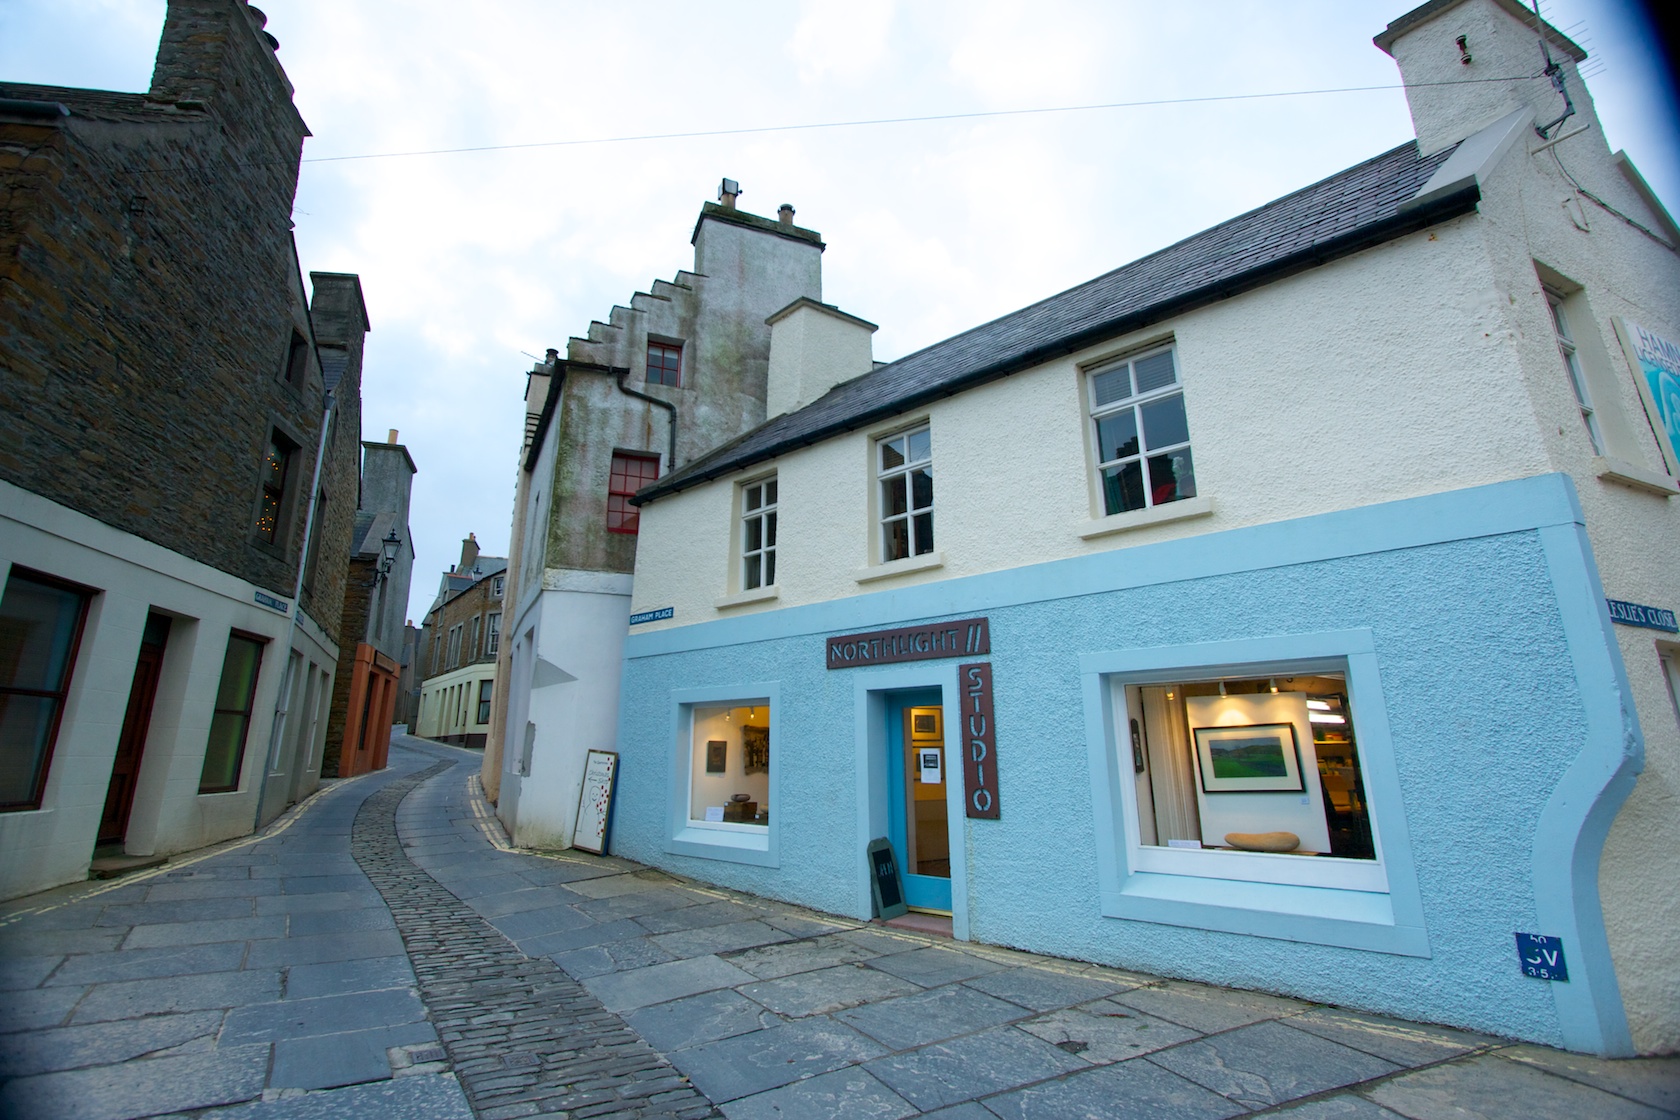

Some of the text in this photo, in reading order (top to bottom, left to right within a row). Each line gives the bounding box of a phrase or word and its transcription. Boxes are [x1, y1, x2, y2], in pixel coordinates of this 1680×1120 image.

[631, 608, 673, 624] GRAHAM PLACE
[1646, 608, 1677, 628] CLOSE
[830, 628, 960, 662] NORTHLIGHT
[967, 667, 992, 812] STUDIO
